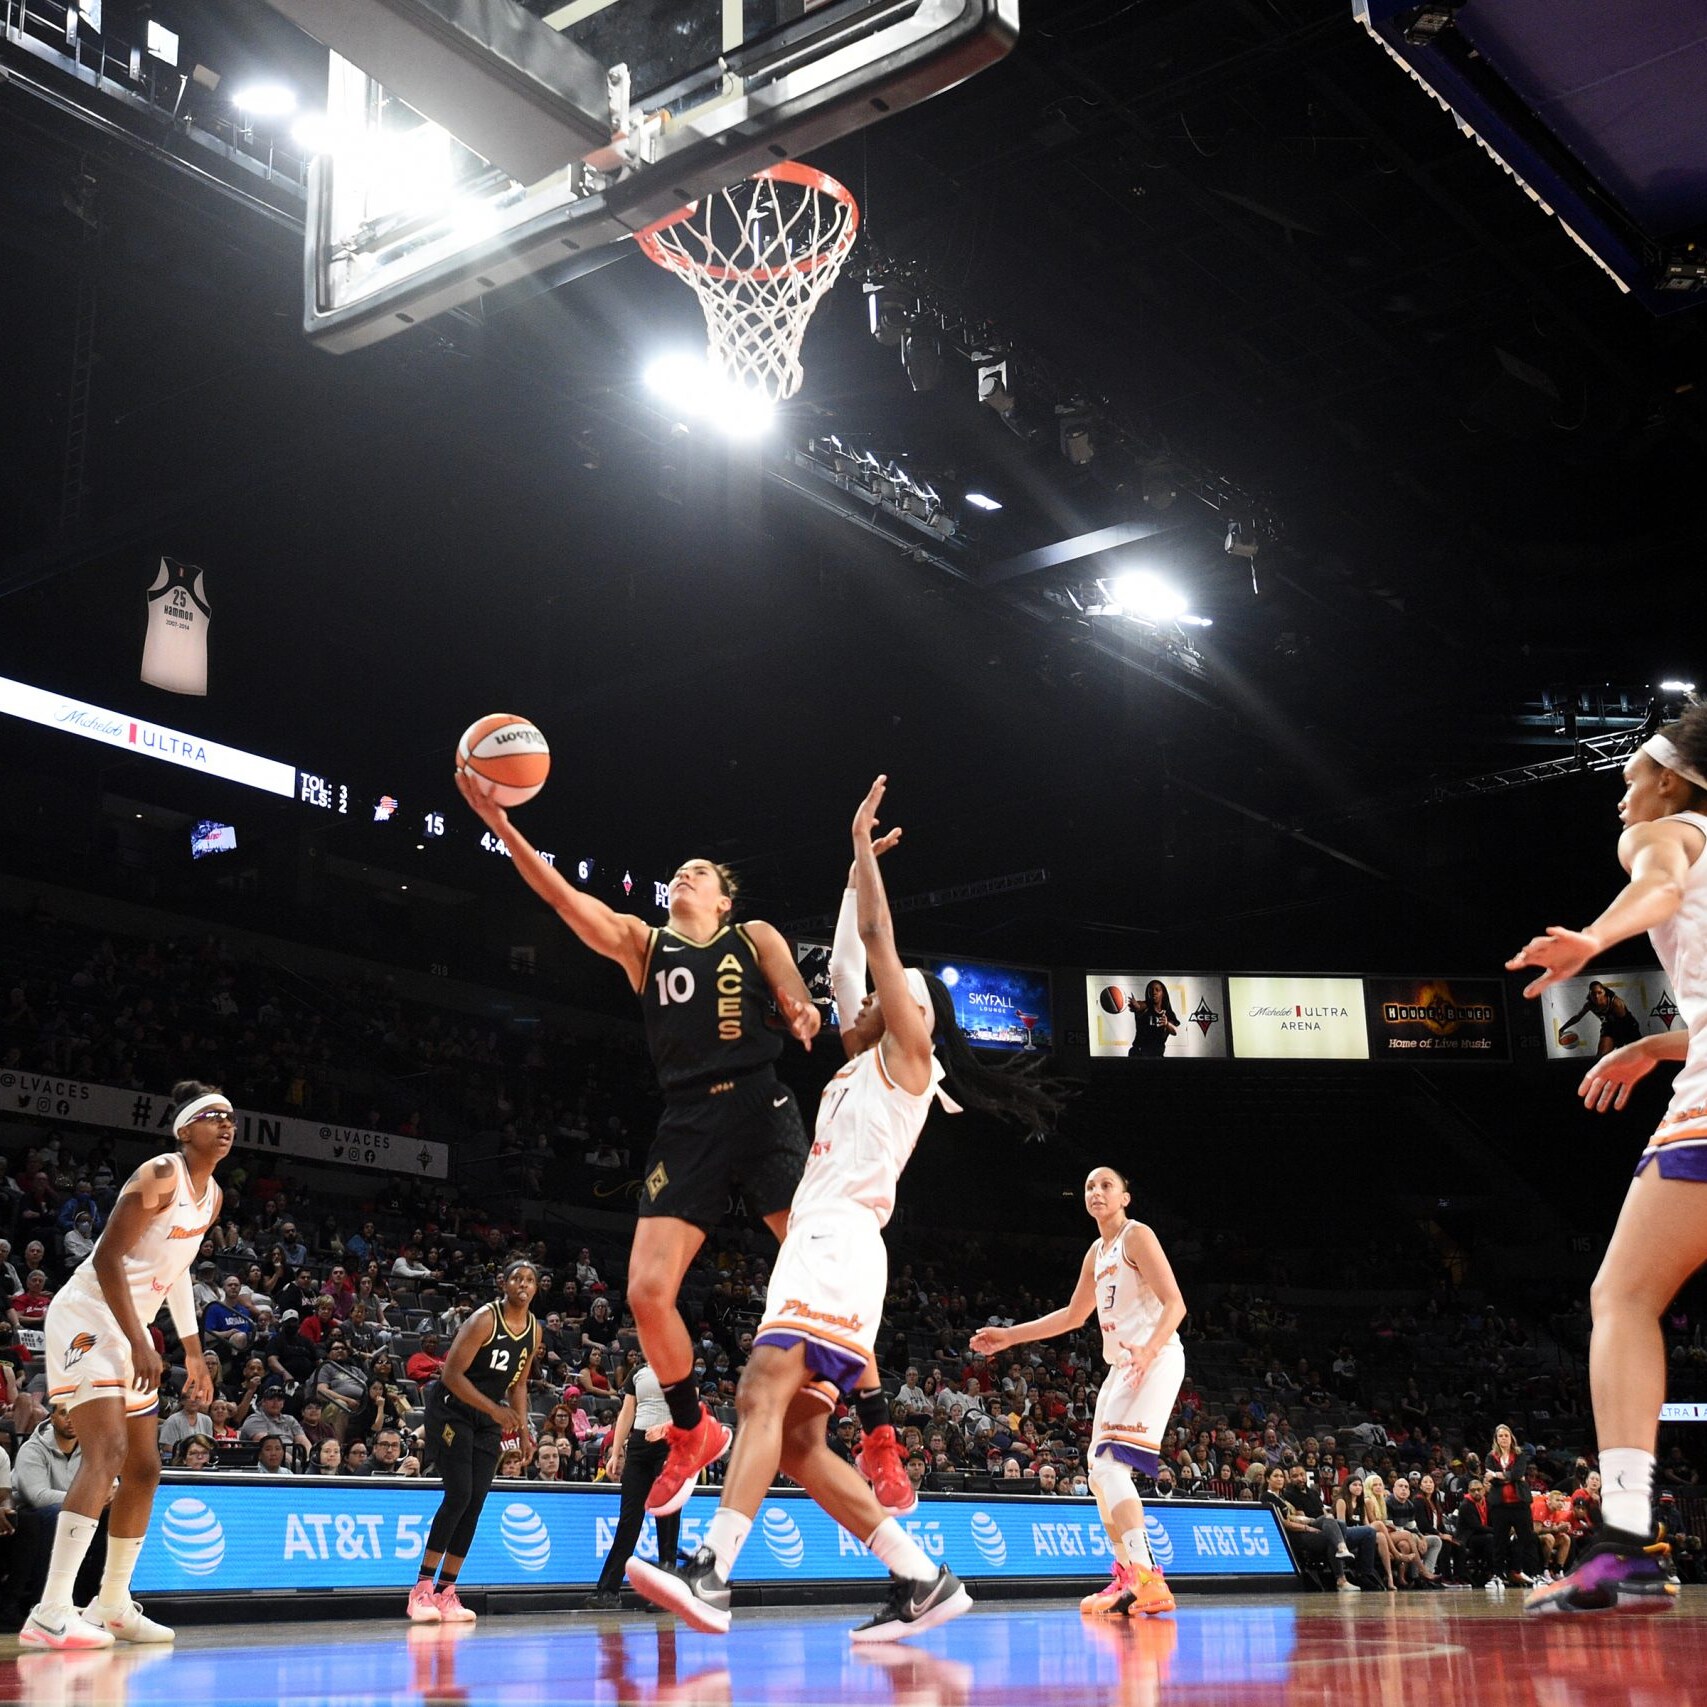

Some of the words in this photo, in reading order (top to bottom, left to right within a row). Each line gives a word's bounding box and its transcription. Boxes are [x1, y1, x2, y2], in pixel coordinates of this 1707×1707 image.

[172, 588, 187, 608] 25
[163, 604, 194, 622] Hammon
[53, 705, 123, 737] Michelob
[143, 729, 207, 764] ULTRA
[300, 772, 333, 796] TOL:
[339, 784, 348, 800] 3
[301, 787, 332, 809] FLS:
[338, 799, 348, 814] 2
[424, 813, 445, 836] 15
[577, 860, 589, 880] 6
[655, 966, 695, 1007] 10
[716, 953, 744, 1040] ACES
[968, 992, 1015, 1009] SKYFALL
[979, 1006, 1006, 1014] LOUNGE
[1190, 1013, 1218, 1022] ACES
[1249, 1006, 1292, 1017] Michelob
[1304, 1007, 1348, 1017] ULTRA
[1280, 1021, 1321, 1031] ARENA
[1388, 1038, 1417, 1049] Home
[1419, 1038, 1432, 1049] of
[1434, 1038, 1458, 1049] Live
[1461, 1038, 1492, 1049] Music
[1, 1073, 90, 1100] @LVACES
[319, 1126, 391, 1149] @LVACES
[1103, 1284, 1116, 1310] 3
[489, 1349, 510, 1371] 12
[284, 1514, 384, 1560] AT&T
[682, 1518, 712, 1558] 5
[1032, 1523, 1086, 1556] AT&T
[1192, 1525, 1240, 1556] AT&T
[1240, 1526, 1270, 1556] 5G
